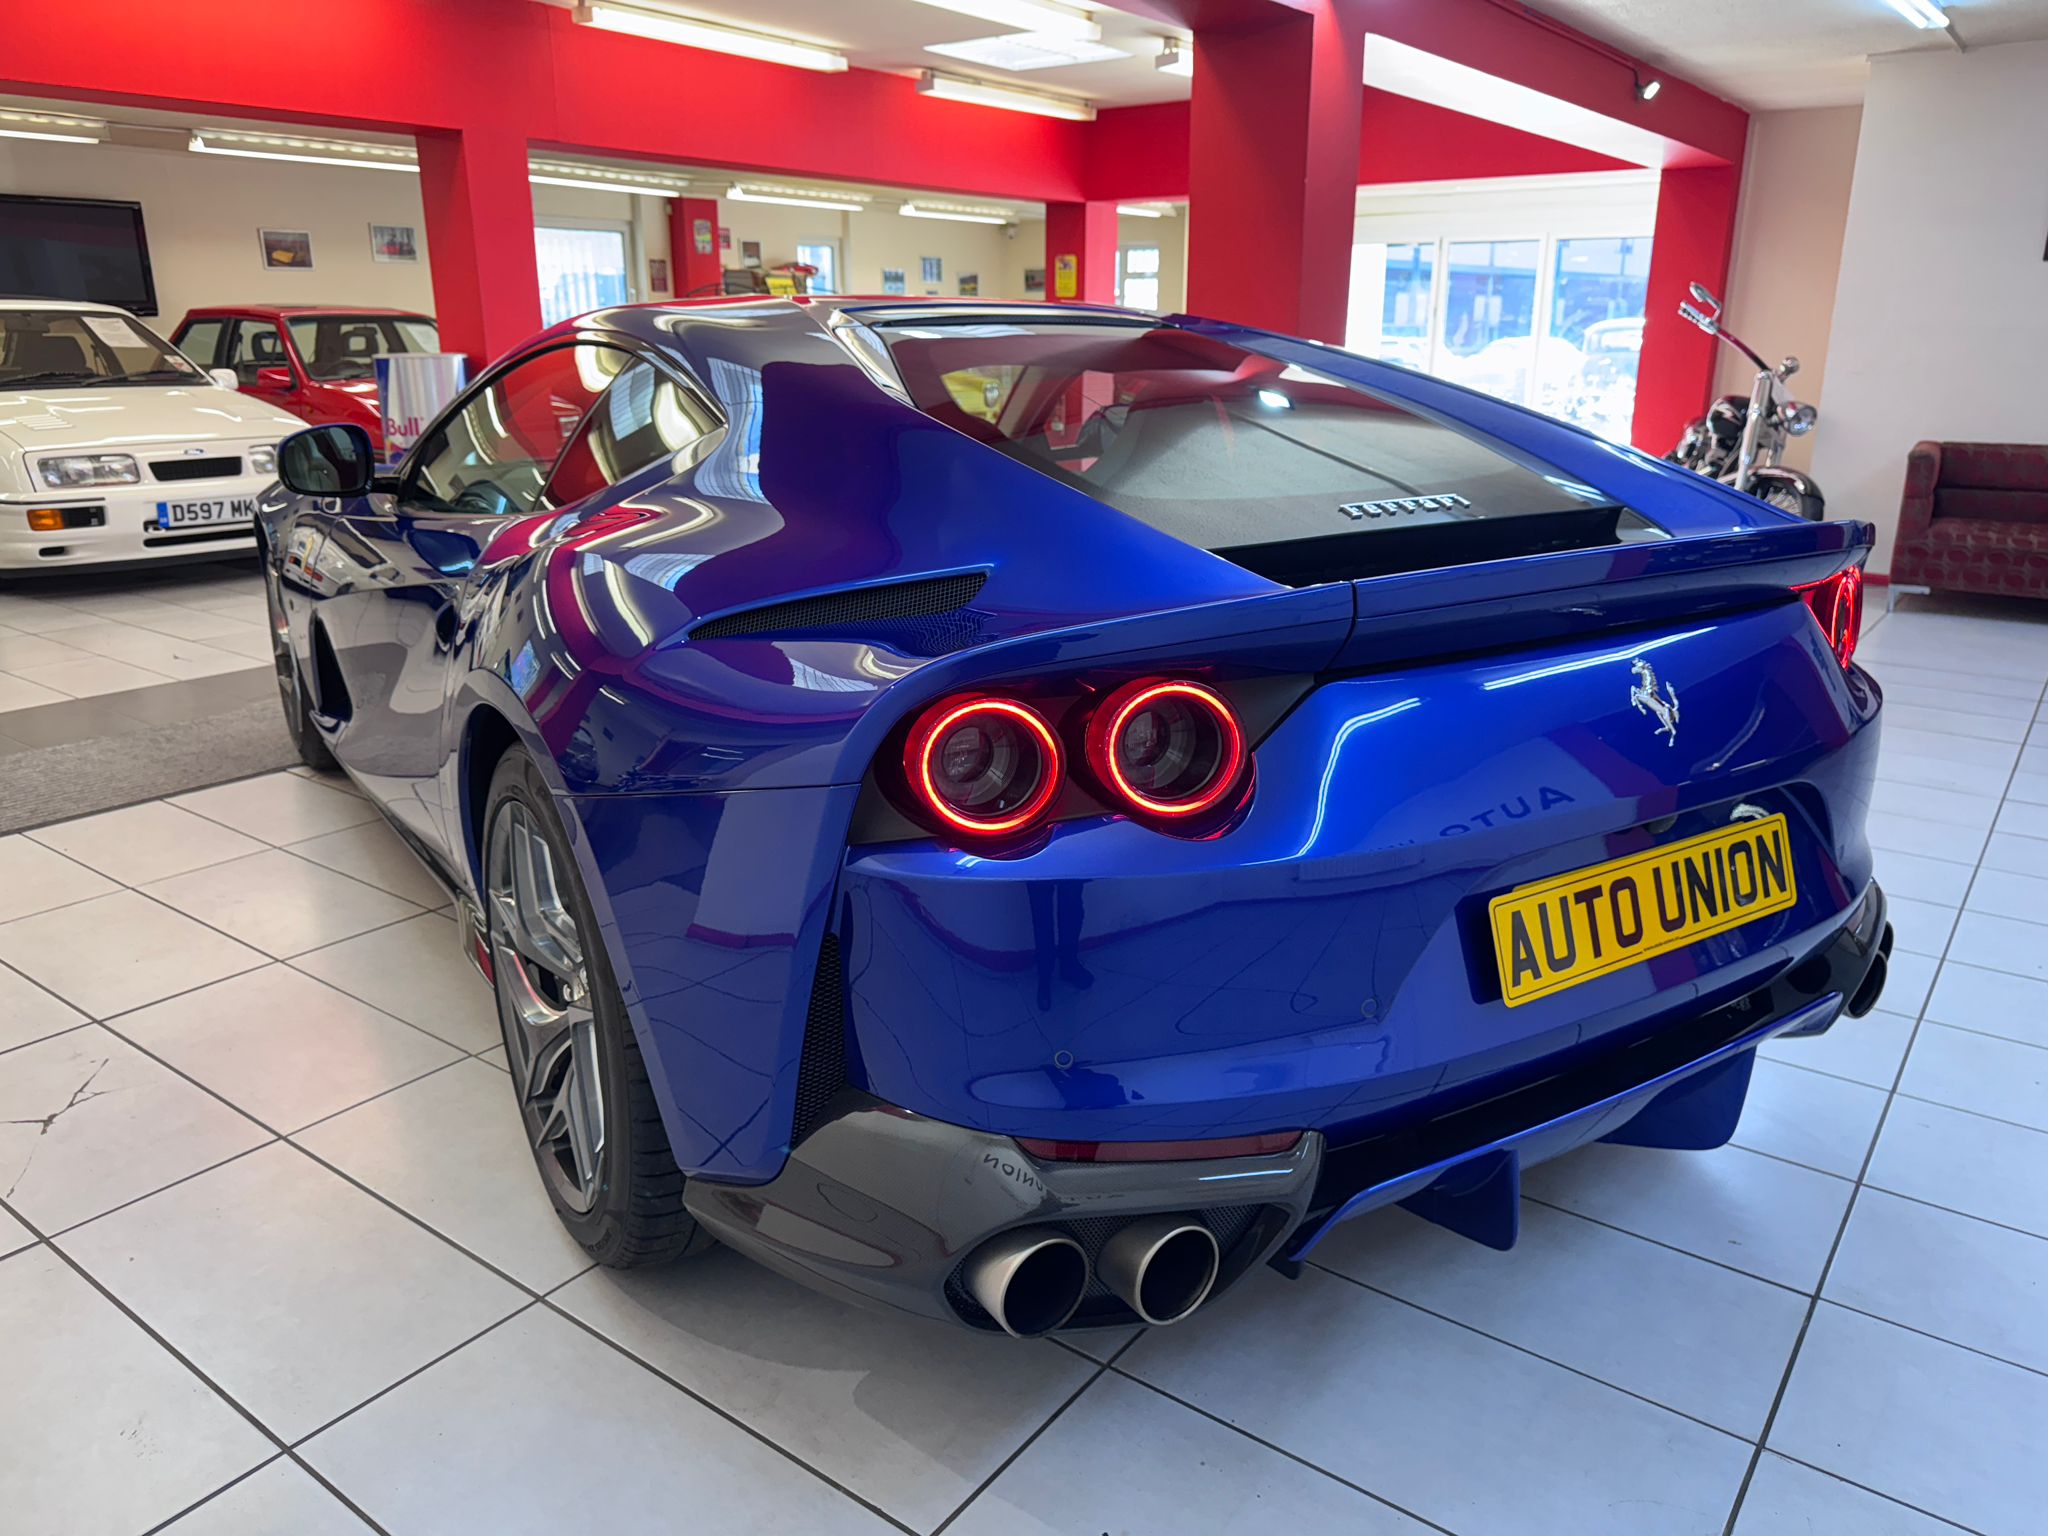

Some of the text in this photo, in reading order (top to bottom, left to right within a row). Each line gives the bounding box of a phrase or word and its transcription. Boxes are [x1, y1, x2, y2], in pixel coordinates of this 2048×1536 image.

[386, 417, 420, 436] Bull
[172, 502, 224, 522] D597
[1338, 494, 1471, 520] Ferrari
[1511, 830, 1787, 988] AUTO UNION
